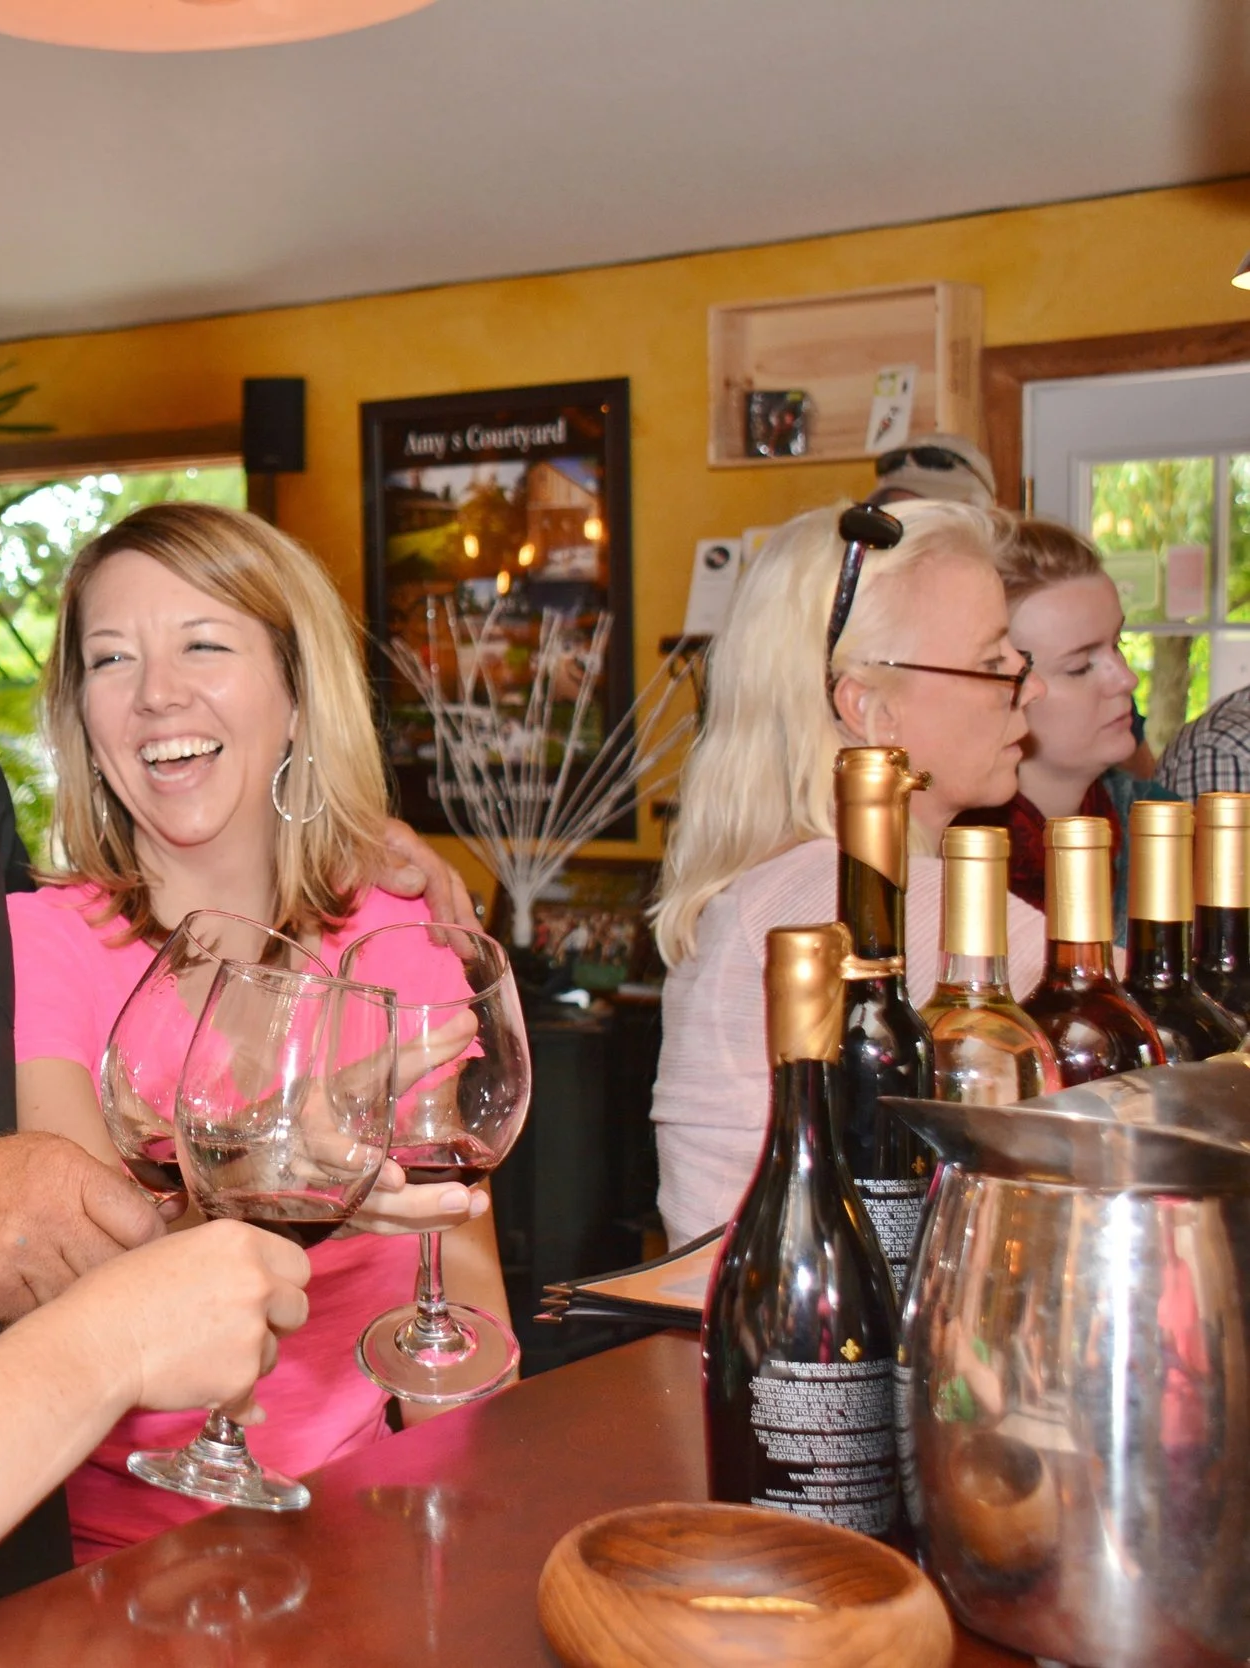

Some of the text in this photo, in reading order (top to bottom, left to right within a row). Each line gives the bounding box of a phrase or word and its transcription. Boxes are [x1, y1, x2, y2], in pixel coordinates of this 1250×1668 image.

[404, 431, 446, 460] Amy
[465, 414, 566, 453] Courtyard
[769, 1359, 788, 1368] THE
[787, 1361, 827, 1370] MEANING
[827, 1362, 839, 1370] OF
[840, 1361, 867, 1370] MAISON
[840, 1369, 851, 1377] OF
[851, 1369, 867, 1377] THE
[748, 1382, 798, 1395] COURTYARD
[752, 1375, 781, 1386] MAISON
[795, 1381, 822, 1389] BELLE
[837, 1379, 868, 1389] WINERY
[753, 1389, 807, 1402] SURROUNDED
[751, 1403, 797, 1416] ATTENTION
[798, 1408, 810, 1416] TO
[758, 1397, 776, 1406] OUR
[776, 1400, 808, 1409] GRAPES
[828, 1401, 863, 1410] TREATED
[750, 1410, 778, 1421] ORDER
[779, 1414, 791, 1422] TO
[791, 1416, 829, 1424] IMPROVE
[830, 1416, 846, 1424] THE
[750, 1416, 767, 1426] ARE
[767, 1419, 803, 1429] LOOKING
[820, 1422, 854, 1431] QUALITY
[754, 1428, 770, 1438] THE
[770, 1431, 793, 1441] GOAL
[793, 1434, 805, 1442] OF
[805, 1434, 824, 1442] OUR
[824, 1434, 855, 1442] WINERY
[758, 1436, 798, 1448] PLEASURE
[798, 1441, 810, 1449] OF
[810, 1441, 839, 1449] GREAT
[839, 1440, 860, 1449] WINE
[766, 1451, 814, 1462] ENJOYMENT
[814, 1455, 826, 1463] TO
[826, 1455, 851, 1463] SHARE
[768, 1444, 811, 1456] BEAUTIFUL
[811, 1448, 851, 1457] WESTERN
[813, 1467, 835, 1475] CALL
[765, 1488, 795, 1498] MAISON
[795, 1491, 807, 1500] LA
[807, 1492, 832, 1500] BELLE
[832, 1492, 846, 1500] VIE
[802, 1485, 832, 1494] VINTED
[833, 1485, 849, 1494] AND
